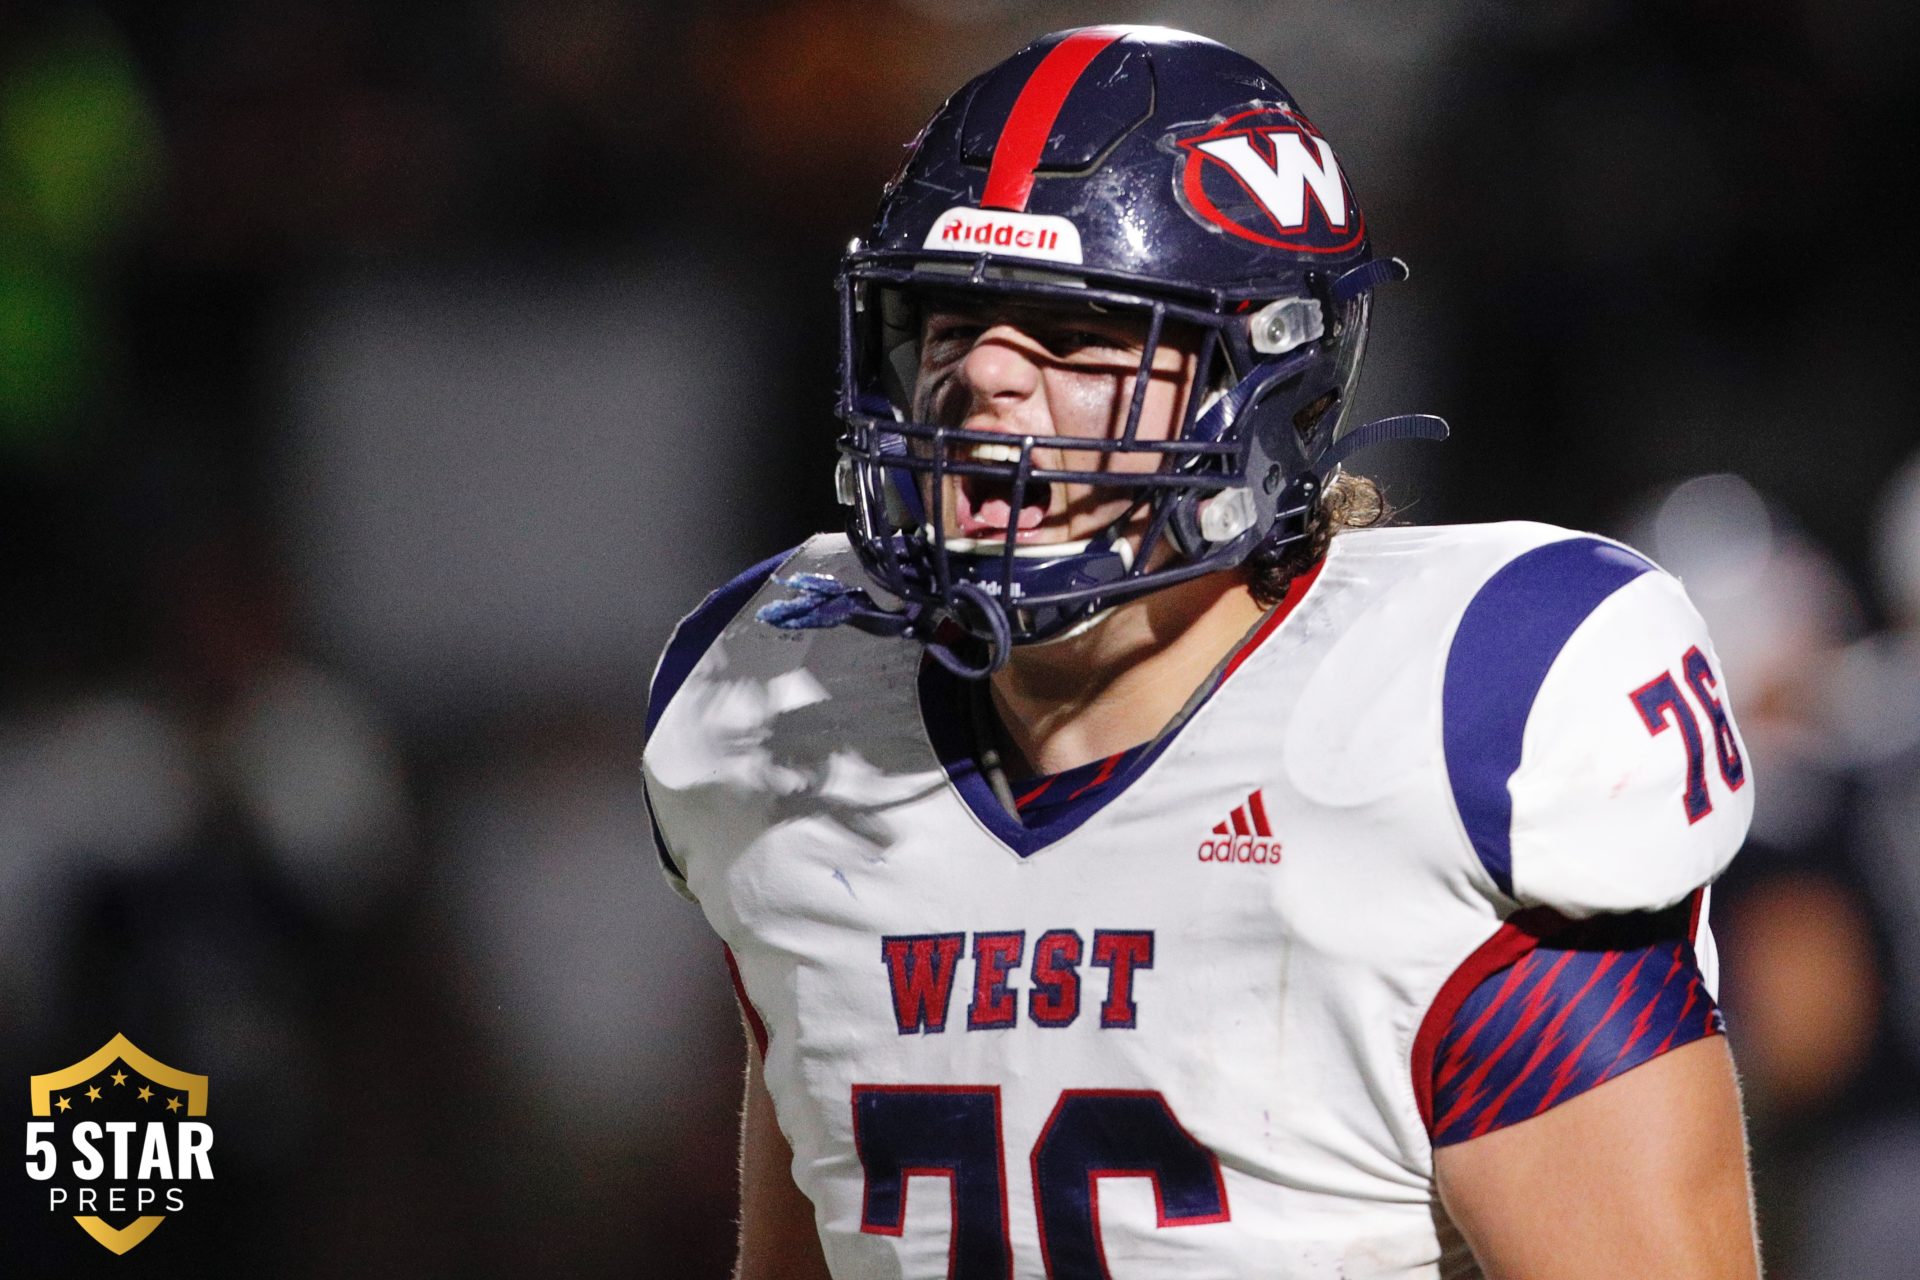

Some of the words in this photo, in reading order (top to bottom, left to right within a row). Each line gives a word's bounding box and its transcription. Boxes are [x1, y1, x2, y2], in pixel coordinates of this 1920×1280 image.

[1196, 132, 1346, 229] W
[942, 219, 1058, 250] Riddell
[1629, 644, 1746, 826] 76
[1198, 834, 1283, 864] adidas
[881, 928, 1156, 1035] WEST
